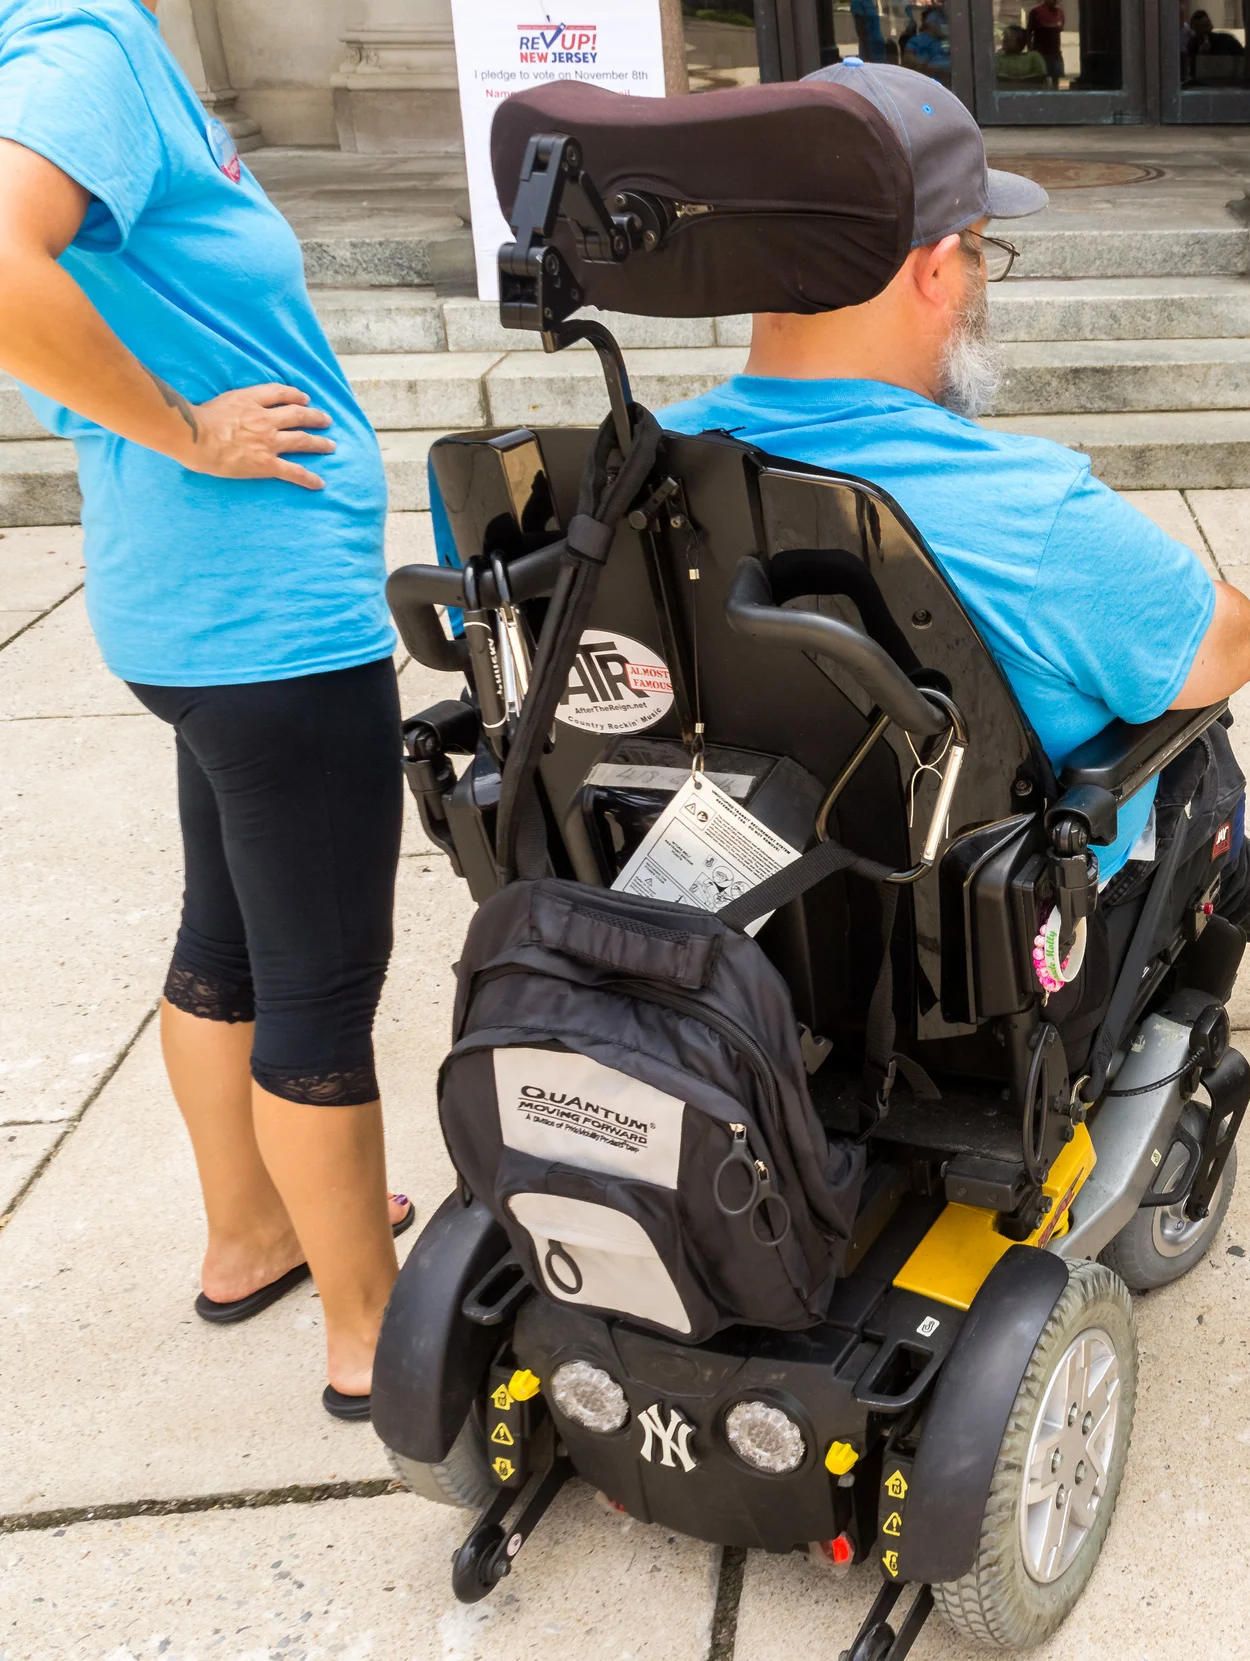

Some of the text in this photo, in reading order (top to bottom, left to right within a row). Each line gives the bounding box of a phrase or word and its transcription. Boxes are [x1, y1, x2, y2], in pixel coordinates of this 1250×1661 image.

[520, 52, 598, 64] NEW JERSEY
[481, 70, 516, 81] pledge
[520, 70, 529, 79] to
[533, 71, 555, 80] vote
[559, 72, 571, 80] on
[575, 70, 628, 80] November
[632, 70, 648, 80] 8th
[630, 666, 669, 679] ALMOST
[633, 678, 673, 690] FAMOUS
[575, 702, 648, 714] AfterTheReign.net
[568, 708, 662, 730] Country Rockin' Music
[521, 1086, 648, 1134] QUANTUM
[519, 1101, 647, 1144] MOVING FORWARD
[638, 1403, 698, 1473] NY
